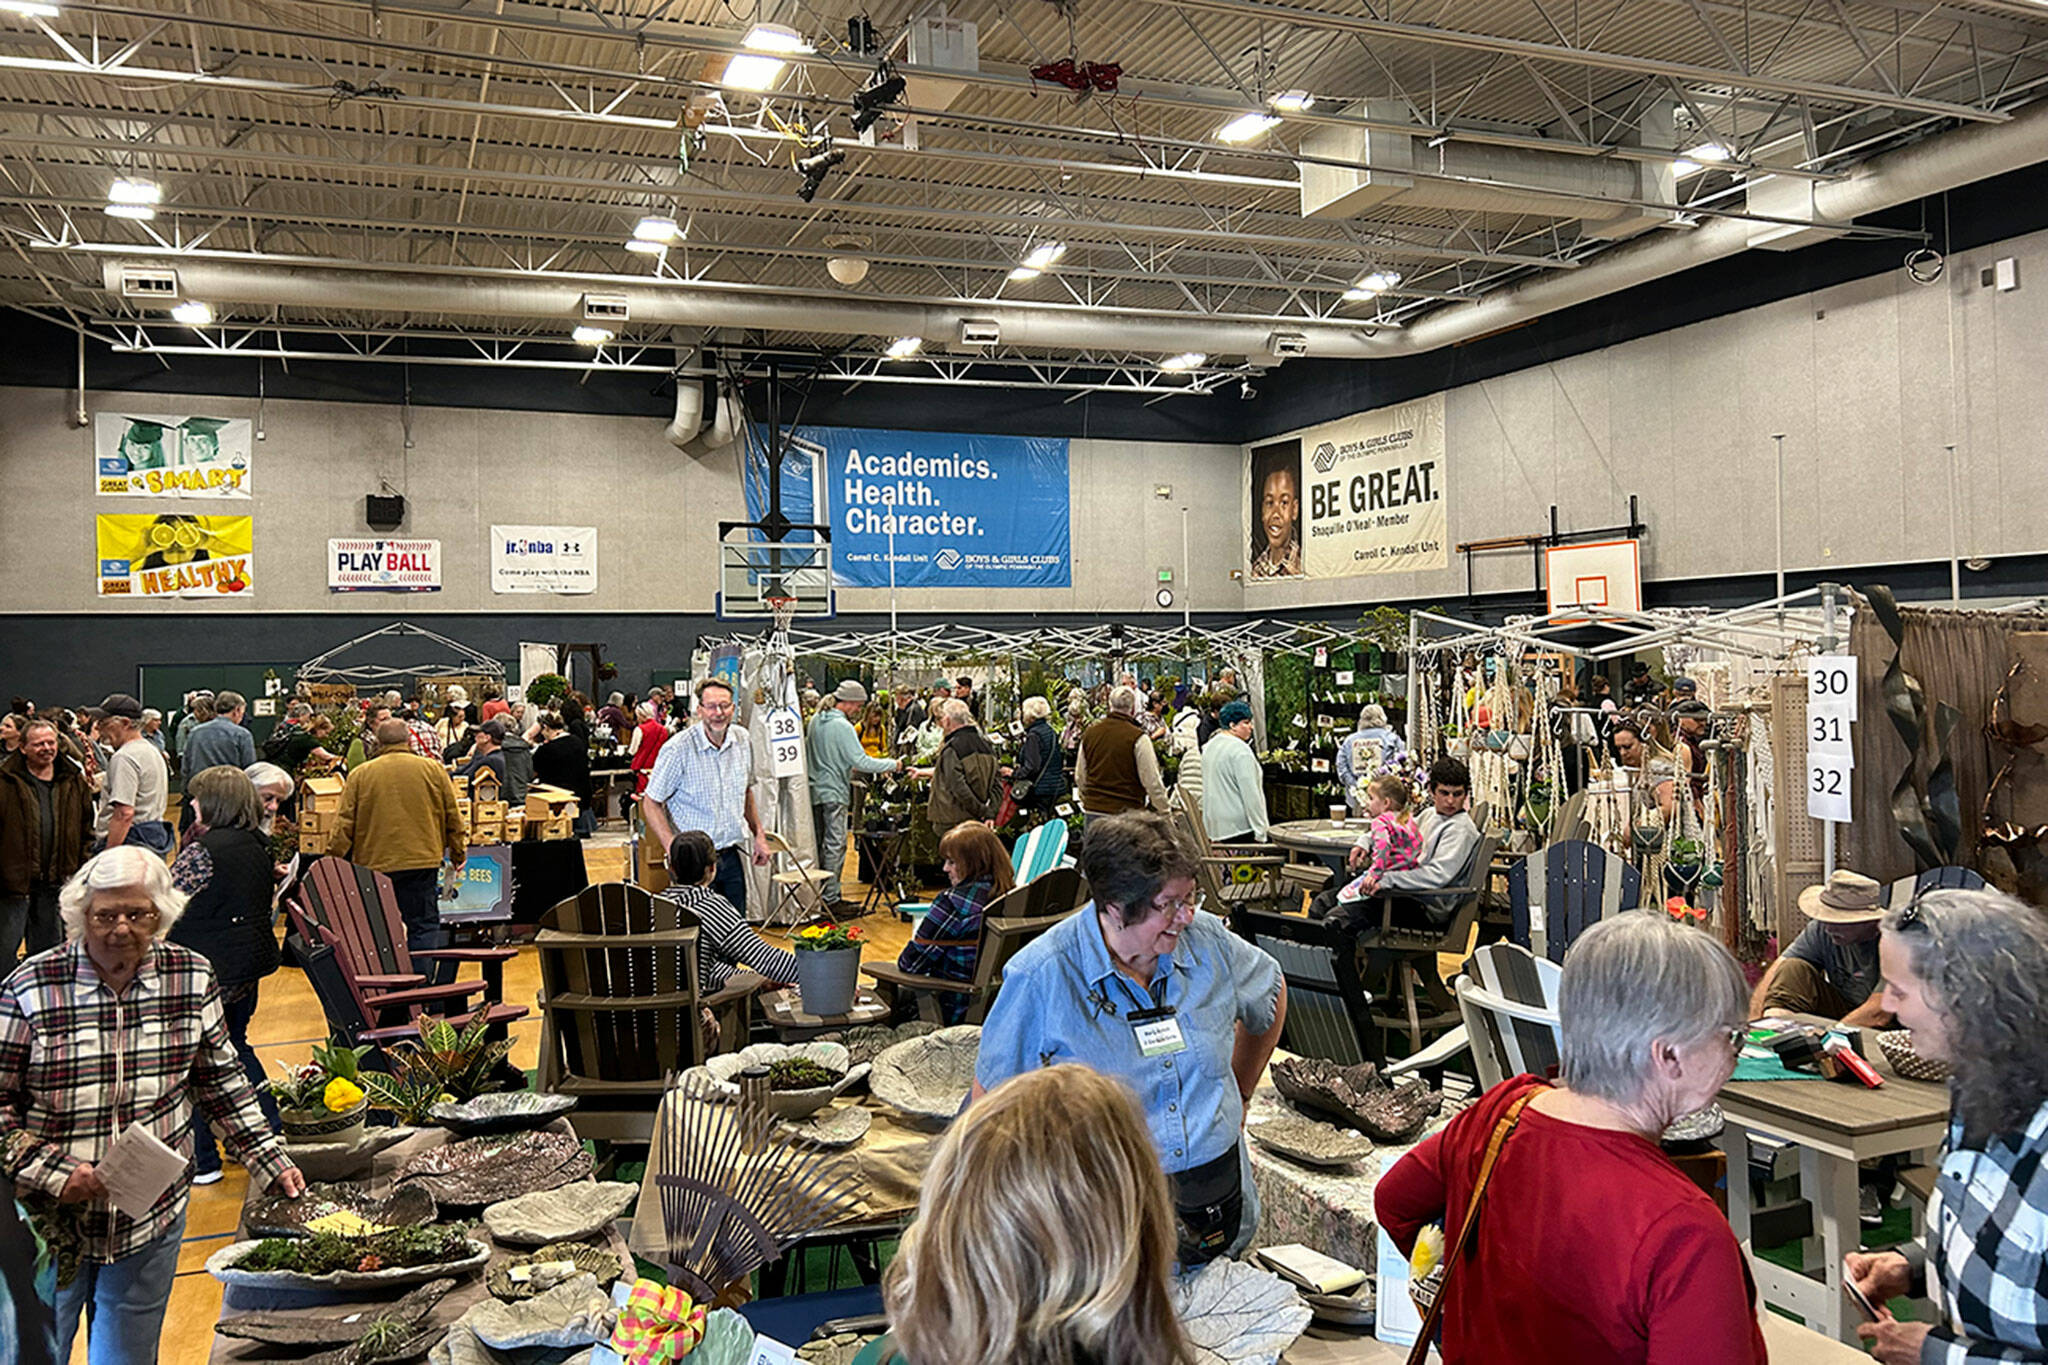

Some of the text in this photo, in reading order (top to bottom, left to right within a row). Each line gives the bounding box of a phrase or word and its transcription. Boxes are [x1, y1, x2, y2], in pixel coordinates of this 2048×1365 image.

[845, 449, 998, 480] Academics.
[145, 468, 247, 493] SMART
[1311, 461, 1439, 520] BE GREAT.
[845, 479, 940, 507] Health.
[846, 507, 984, 536] Character.
[1312, 521, 1345, 537] Shaquille
[1377, 513, 1409, 527] Member
[528, 540, 553, 554] nba
[884, 553, 911, 562] Kndall
[913, 554, 928, 562] Unit
[965, 554, 1060, 564] BOYS & GIRLS CLUBS
[1353, 540, 1440, 560] Carroll C. Kendall Unit
[338, 553, 431, 571] PLAY BALL
[522, 569, 540, 577] play
[141, 559, 246, 594] HEALTHY
[1814, 670, 1849, 695] 30
[774, 719, 795, 735] 38
[1813, 717, 1843, 742] 31
[777, 745, 798, 762] 39
[1812, 767, 1843, 796] 32
[469, 868, 493, 883] BEES
